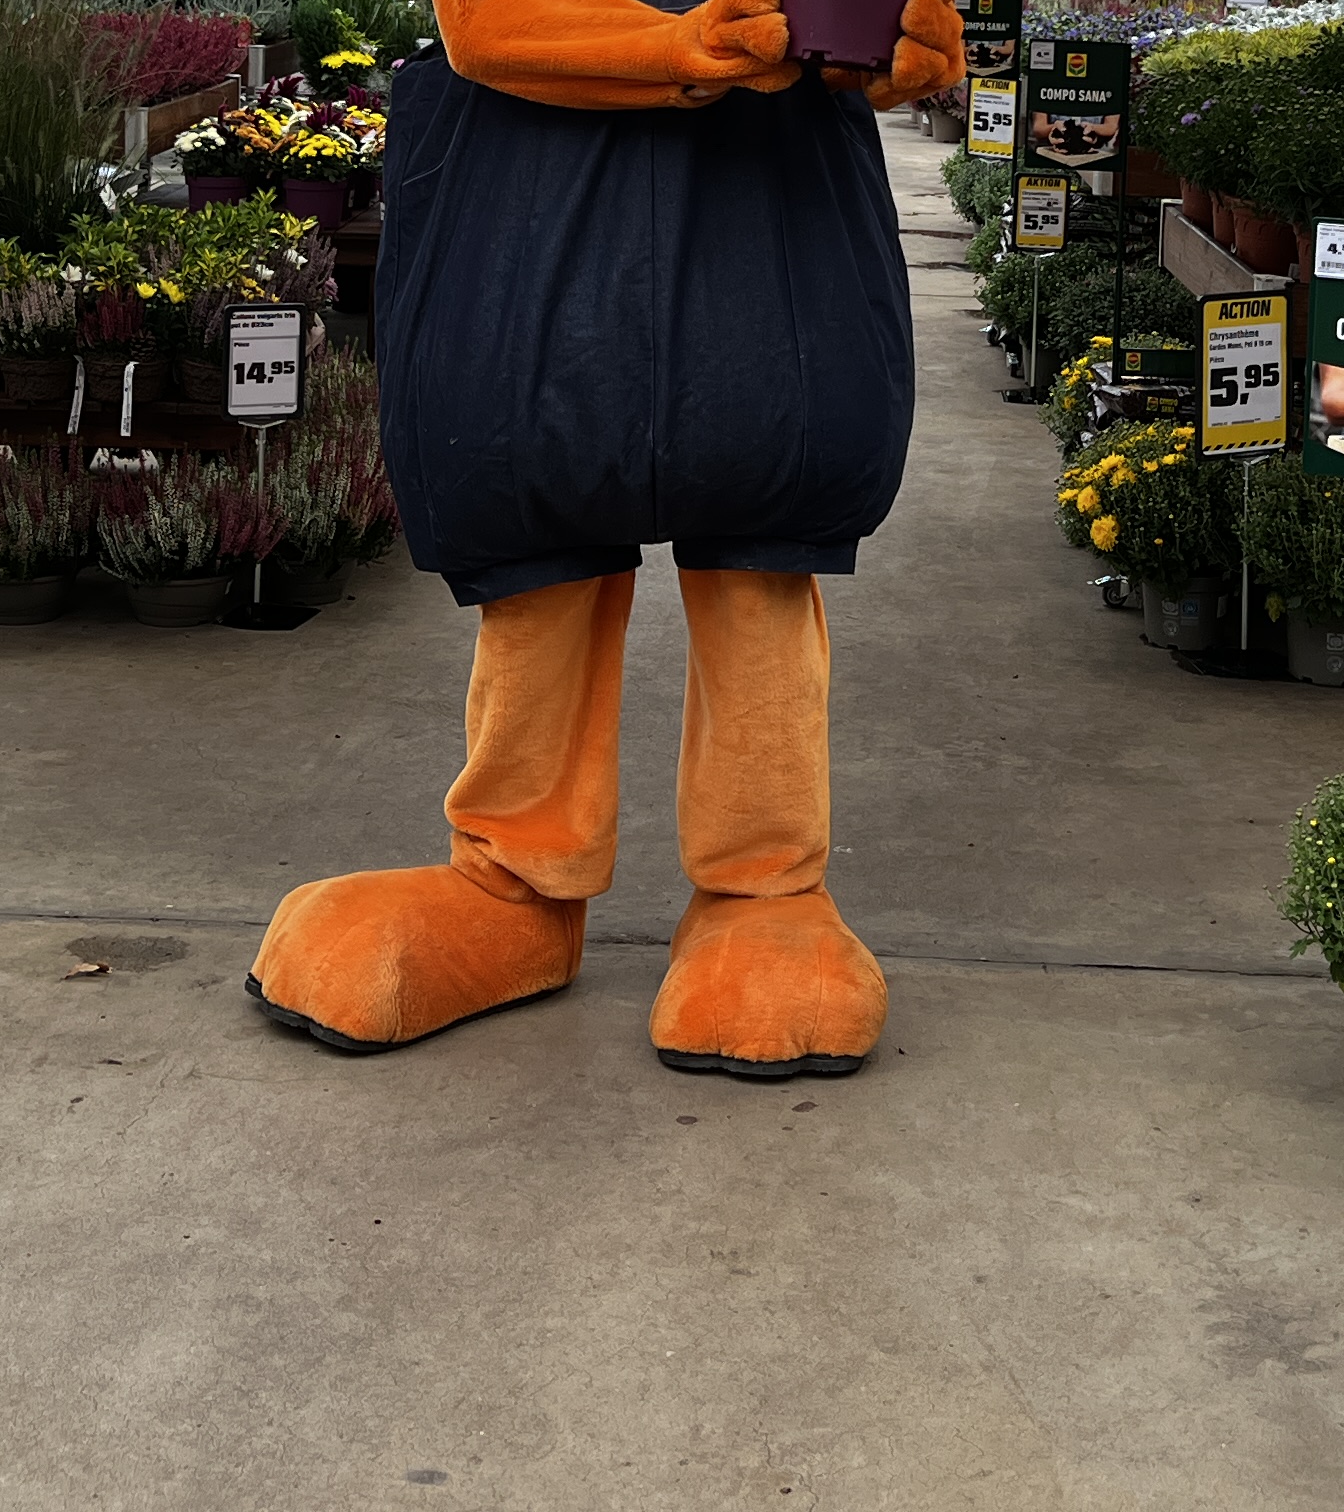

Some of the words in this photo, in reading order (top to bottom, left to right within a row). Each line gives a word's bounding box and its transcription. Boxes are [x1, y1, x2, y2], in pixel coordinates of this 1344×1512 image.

[964, 21, 986, 31] OMPO
[979, 79, 1011, 90] ACTION
[1040, 88, 1076, 101] COMPO
[1078, 89, 1112, 103] SANA®
[973, 111, 1013, 132] 5,95
[1026, 178, 1061, 187] AKTION
[1024, 214, 1060, 230] 5,95
[1218, 299, 1272, 321] ACTION
[233, 360, 296, 384] 14,95
[1209, 362, 1280, 407] 5,95
